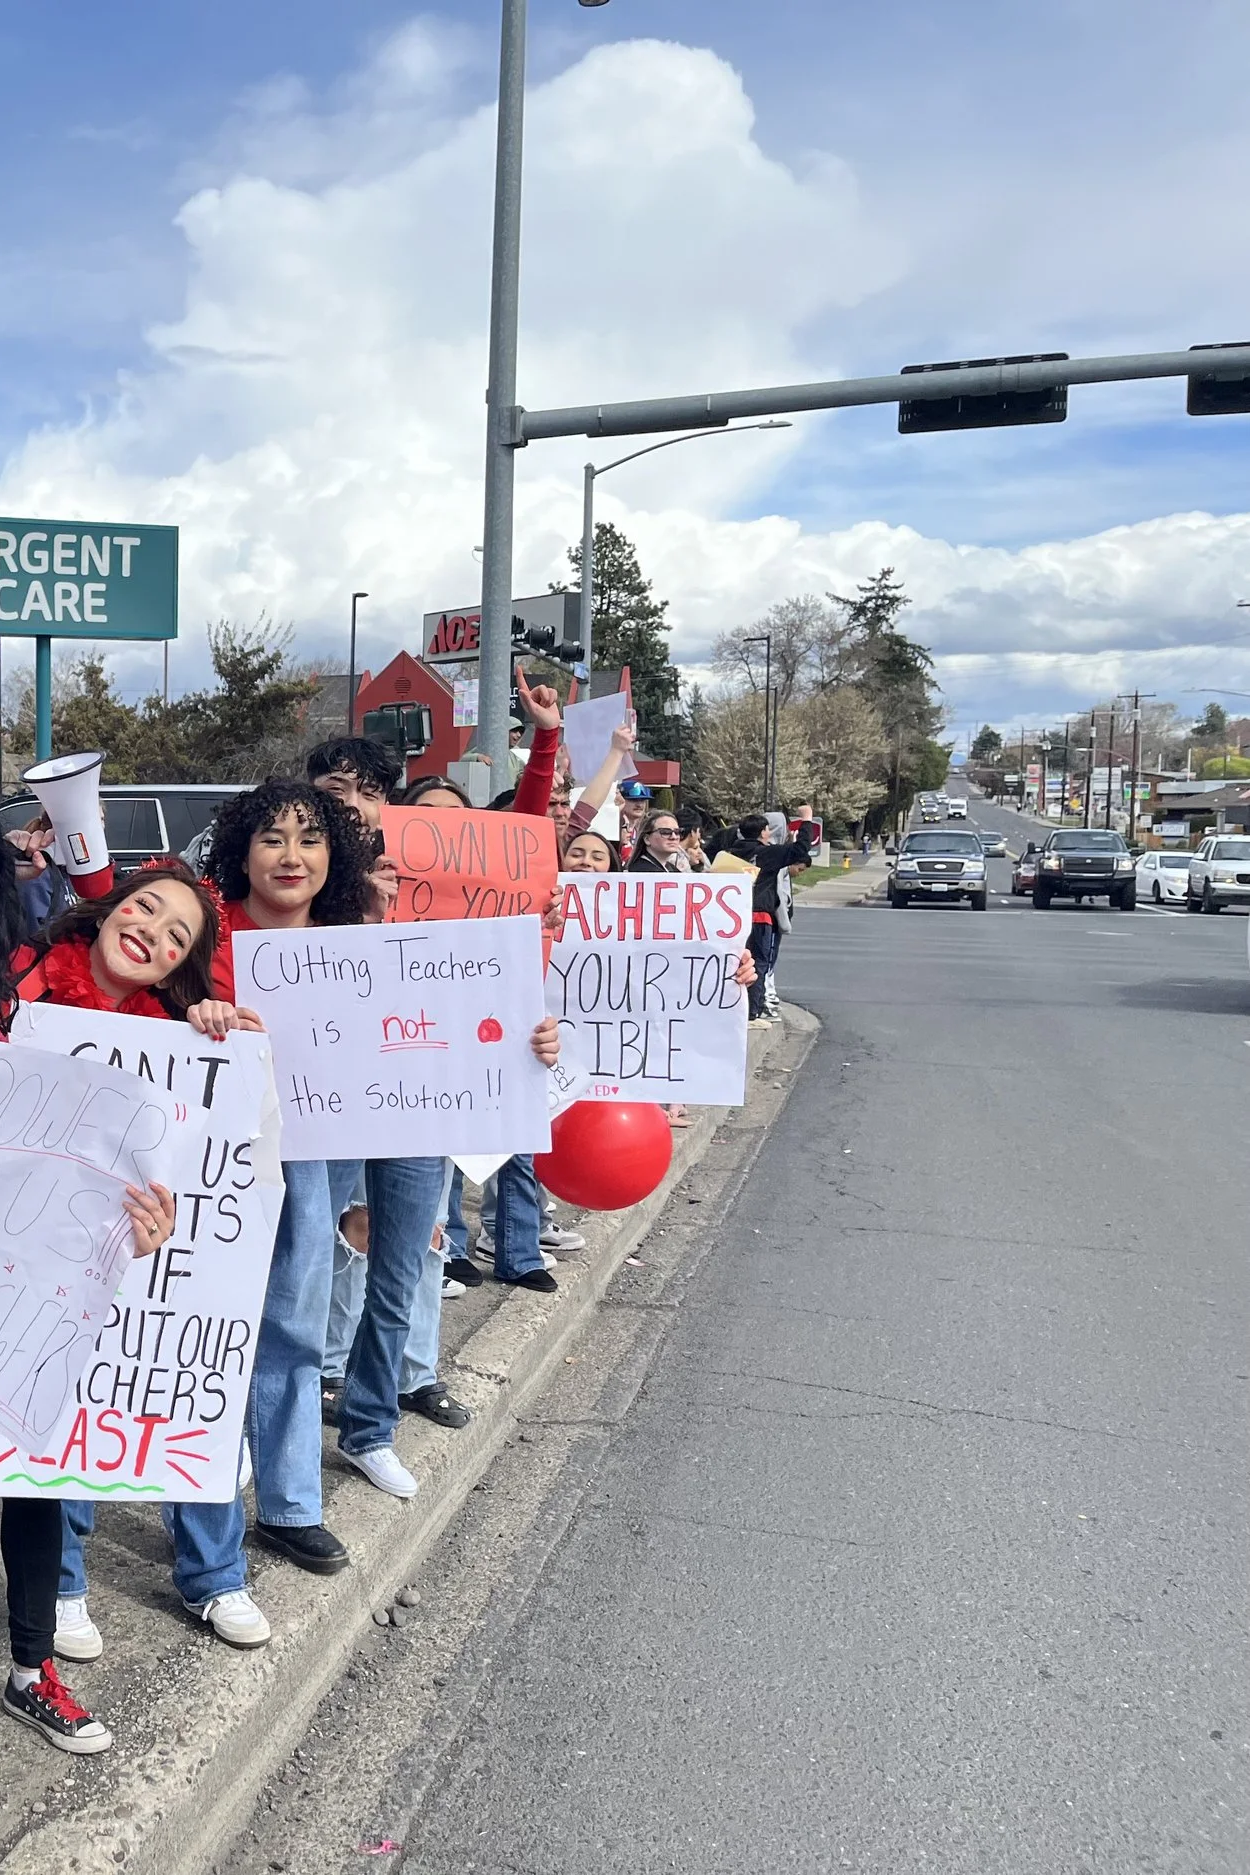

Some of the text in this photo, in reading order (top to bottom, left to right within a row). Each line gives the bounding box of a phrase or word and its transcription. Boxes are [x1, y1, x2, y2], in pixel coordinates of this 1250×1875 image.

[427, 613, 481, 655] ACE
[401, 818, 539, 882] OWN UP
[389, 874, 532, 919] TO YOUR
[384, 936, 502, 982] Teachers
[549, 951, 743, 1017] YOUR JOB
[311, 1008, 437, 1047] is not
[290, 1074, 343, 1117] the
[202, 1136, 256, 1190] US
[147, 1246, 195, 1303] IF
[94, 1303, 251, 1376] PUT OUR
[75, 1361, 227, 1423] CHERS
[28, 1407, 170, 1478] AST
